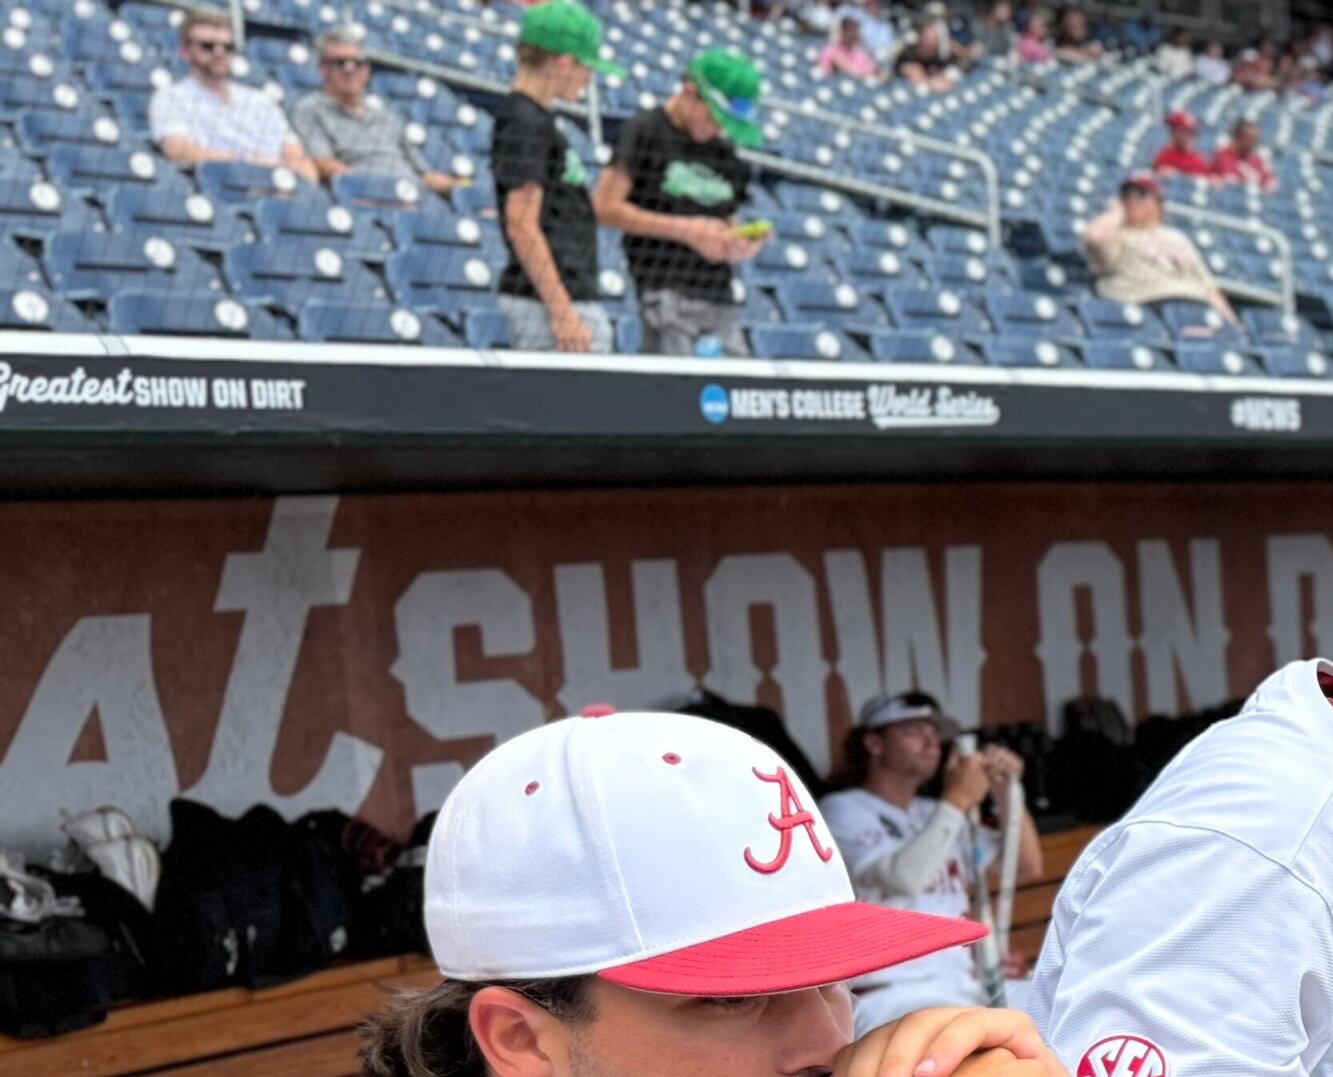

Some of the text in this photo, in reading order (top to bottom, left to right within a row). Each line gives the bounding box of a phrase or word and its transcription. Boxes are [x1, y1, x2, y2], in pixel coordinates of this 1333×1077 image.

[133, 376, 207, 407] SHOW
[211, 378, 247, 409] ON
[250, 379, 306, 410] DIRT
[791, 389, 866, 420] COLLEGE
[1035, 537, 1232, 740] ON
